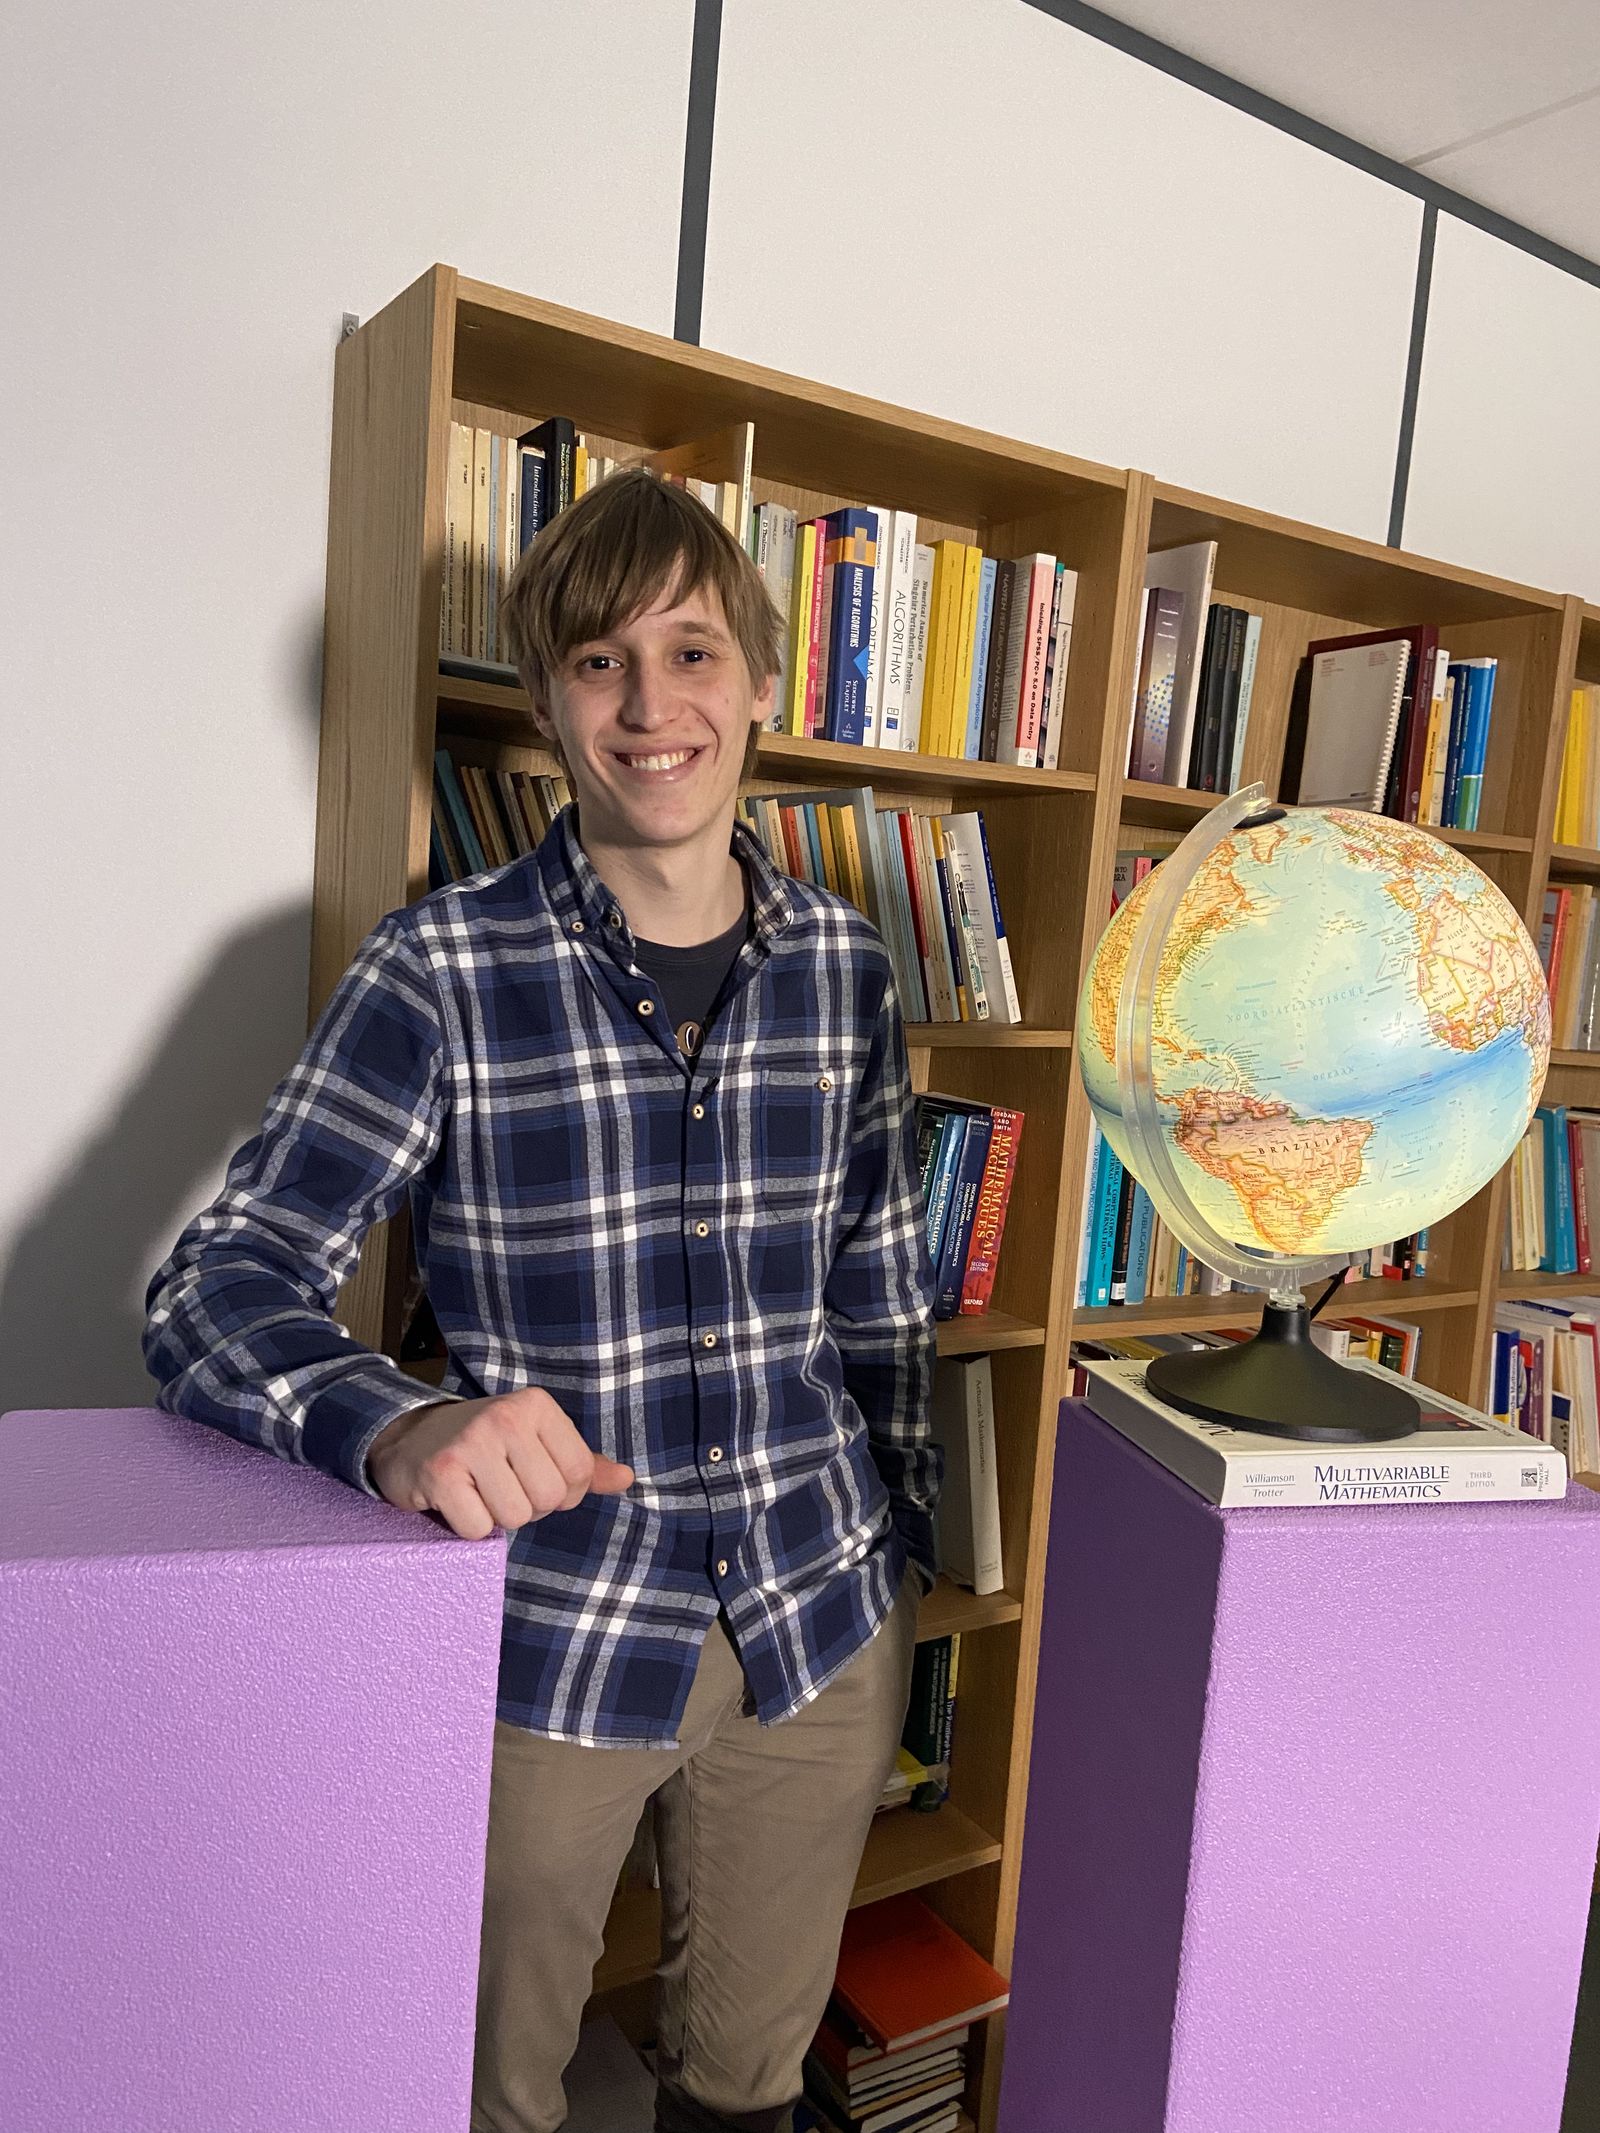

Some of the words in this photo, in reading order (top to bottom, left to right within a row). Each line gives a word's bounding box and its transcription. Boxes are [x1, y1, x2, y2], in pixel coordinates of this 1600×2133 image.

[532, 465, 542, 518] Introduction
[532, 520, 539, 529] to
[817, 533, 825, 576] ALGORITHMS
[853, 567, 864, 597] ANALYSIS
[909, 578, 920, 611] Singular
[920, 580, 930, 618] Numerical
[983, 583, 992, 615] Singular
[852, 597, 862, 606] OF
[849, 607, 861, 648] ALGORITHMS
[890, 590, 906, 685] ALGORITHMS
[906, 613, 918, 660] Perturbation
[917, 620, 926, 651] Analysis
[978, 615, 989, 666] Perturbations
[904, 661, 914, 696] Problems
[977, 667, 985, 682] and
[844, 680, 852, 713] FLAJOLET
[850, 679, 859, 716] SEDGEWICK
[973, 683, 984, 731] Asymptotics
[1026, 722, 1034, 742] Entry
[1091, 1156, 1099, 1170] AND
[940, 1172, 952, 1197] Data
[968, 1183, 978, 1208] DISCRETE
[976, 1135, 1002, 1239] TECHNIQUES
[981, 1135, 1013, 1259] MATHEMATICAL
[1089, 1171, 1097, 1192] SIGNAL
[960, 1183, 972, 1227] COMBINATORIAL
[1103, 1198, 1112, 1236] EXTERNAL
[1108, 1188, 1119, 1239] COMPUTATION
[929, 1199, 946, 1255] Structures
[948, 1213, 960, 1255] INTRODUCTION
[1136, 1205, 1150, 1279] PUBLICATIONS
[952, 1227, 963, 1267] MATHEMATICS
[975, 1380, 984, 1418] Actuarial
[977, 1420, 986, 1475] Mathematics
[1244, 1472, 1296, 1484] Williamson
[1313, 1465, 1450, 1483] MULTIVARIABLE
[1465, 1480, 1496, 1489] EDITION
[1469, 1471, 1493, 1480] THIRD
[1252, 1488, 1285, 1498] Trotter
[1319, 1484, 1442, 1501] MATHEMATICS
